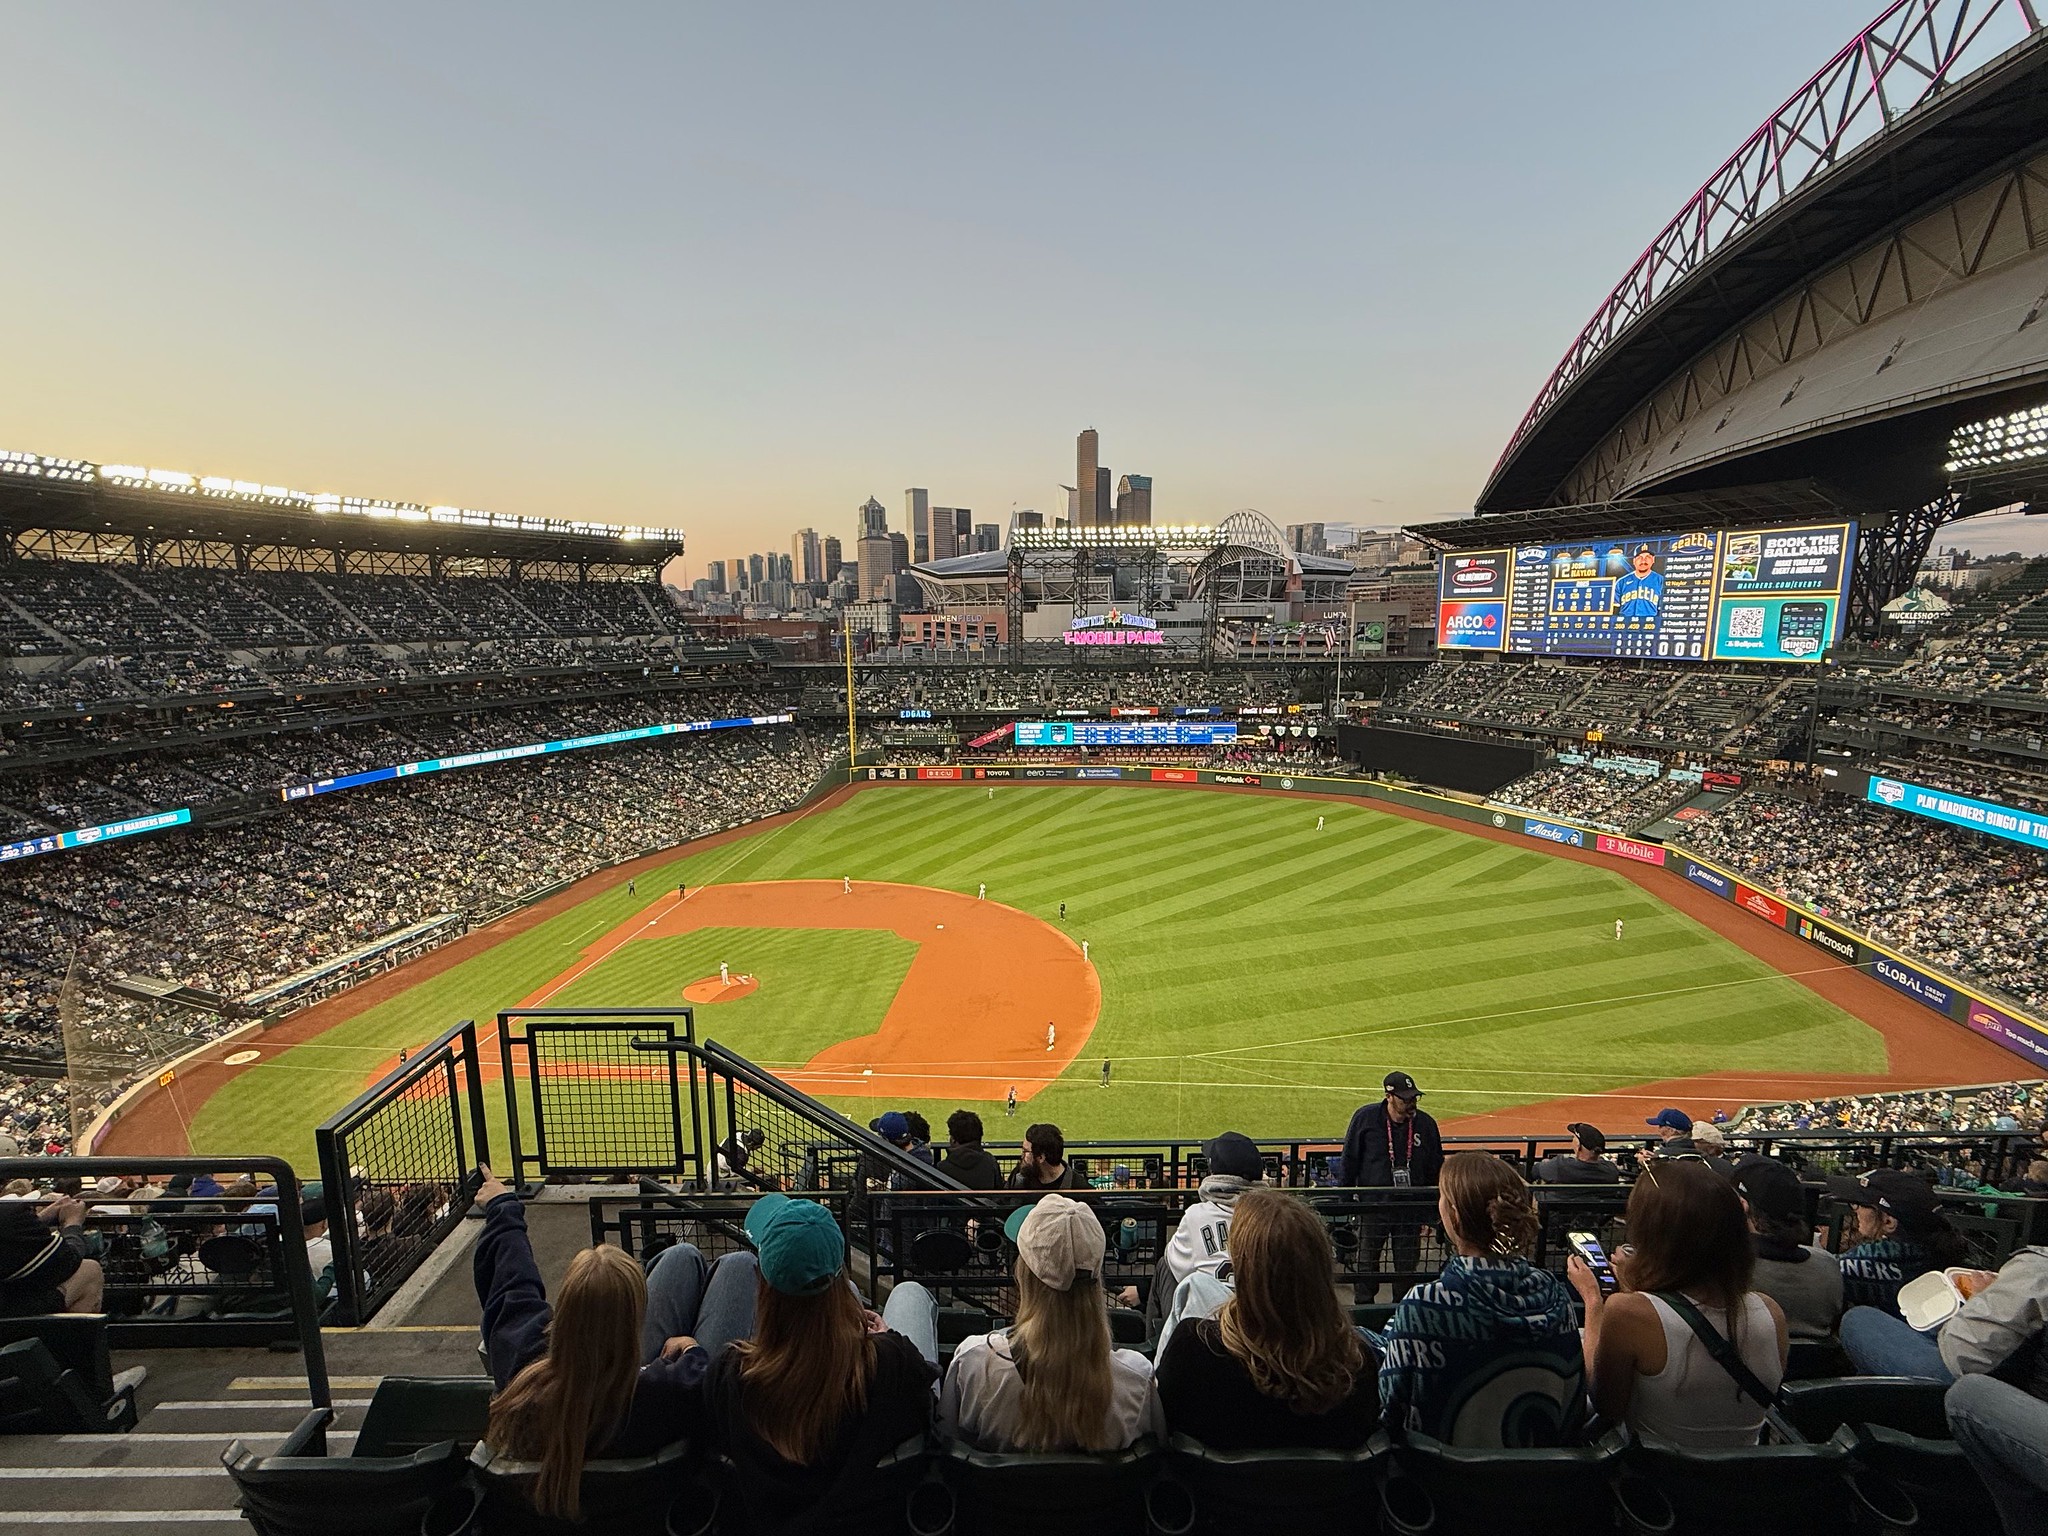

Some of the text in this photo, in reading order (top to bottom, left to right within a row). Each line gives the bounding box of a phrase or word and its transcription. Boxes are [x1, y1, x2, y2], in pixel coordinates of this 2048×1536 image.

[1766, 535, 1839, 548] BOOK THE
[1764, 544, 1840, 558] BALLPARK
[1555, 563, 1570, 578] 12
[1571, 569, 1596, 577] NAYLOR
[1446, 616, 1482, 628] ARCO
[1063, 630, 1164, 645] T-MOBILE PARK
[1783, 641, 1815, 649] BINGO!
[1658, 642, 1701, 657] 0 0 0
[1216, 775, 1244, 783] KeyBank
[1916, 794, 1937, 810] PLAY
[1938, 799, 1985, 823] MARINERS
[1986, 812, 2017, 831] BINGO
[2018, 819, 2031, 835] IN
[106, 814, 178, 835] PLAY MARINERS BINGO
[1527, 823, 1563, 840] Alaska
[22, 846, 34, 854] 20
[41, 842, 53, 850] 92
[1617, 841, 1654, 859] Mobile
[1697, 870, 1724, 887] BOEING
[1813, 928, 1854, 958] Microsoft
[1877, 962, 1923, 994] GLOBAL
[1925, 985, 1946, 999] CREDIT
[1925, 991, 1944, 1004] UNION
[2005, 1028, 2017, 1040] Too
[2017, 1036, 2034, 1048] much
[1405, 1078, 1412, 1088] S
[1413, 1132, 1421, 1147] S
